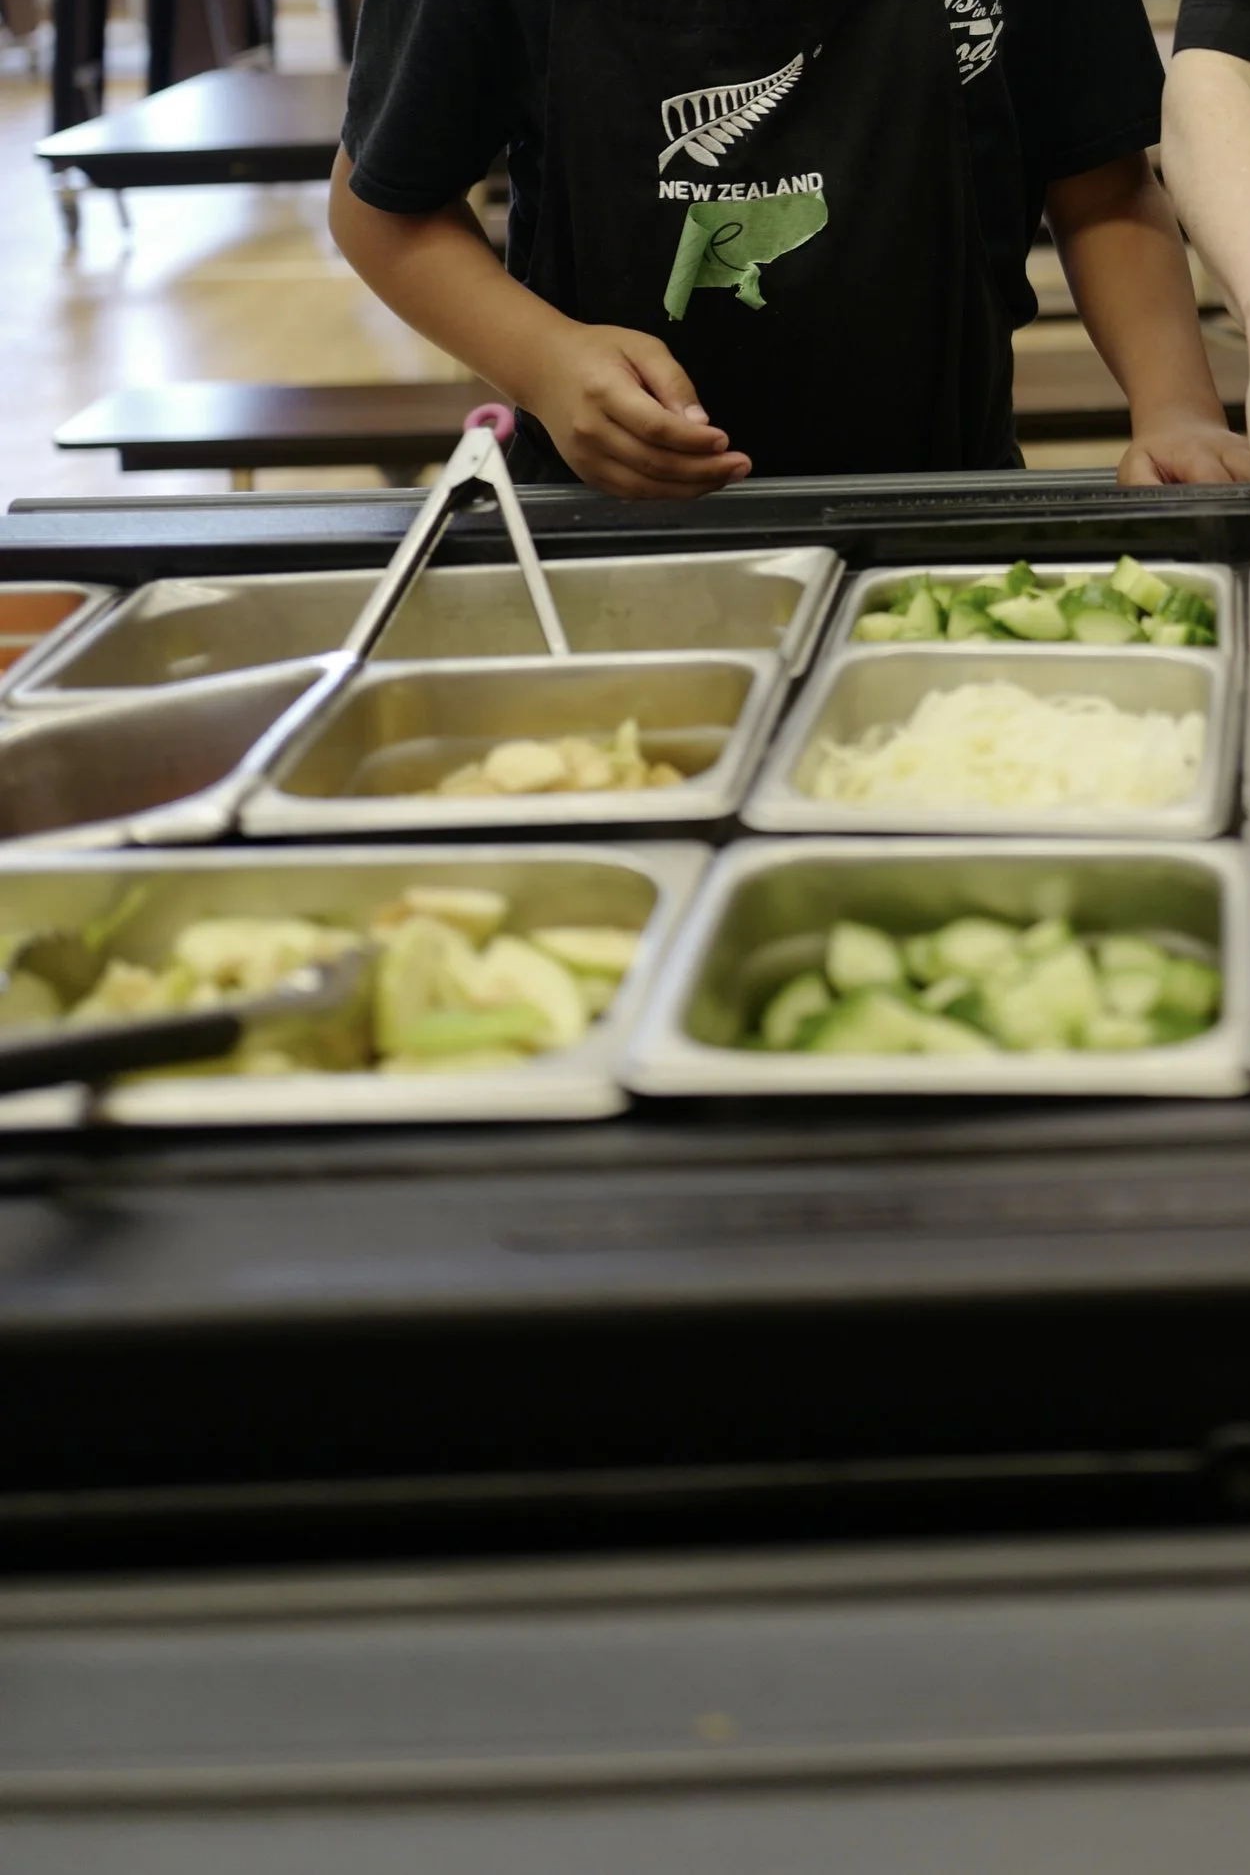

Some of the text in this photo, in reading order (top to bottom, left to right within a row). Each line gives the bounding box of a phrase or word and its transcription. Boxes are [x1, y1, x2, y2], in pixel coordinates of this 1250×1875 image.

[972, 3, 986, 18] in
[659, 172, 824, 202] NEW ZEALAND
